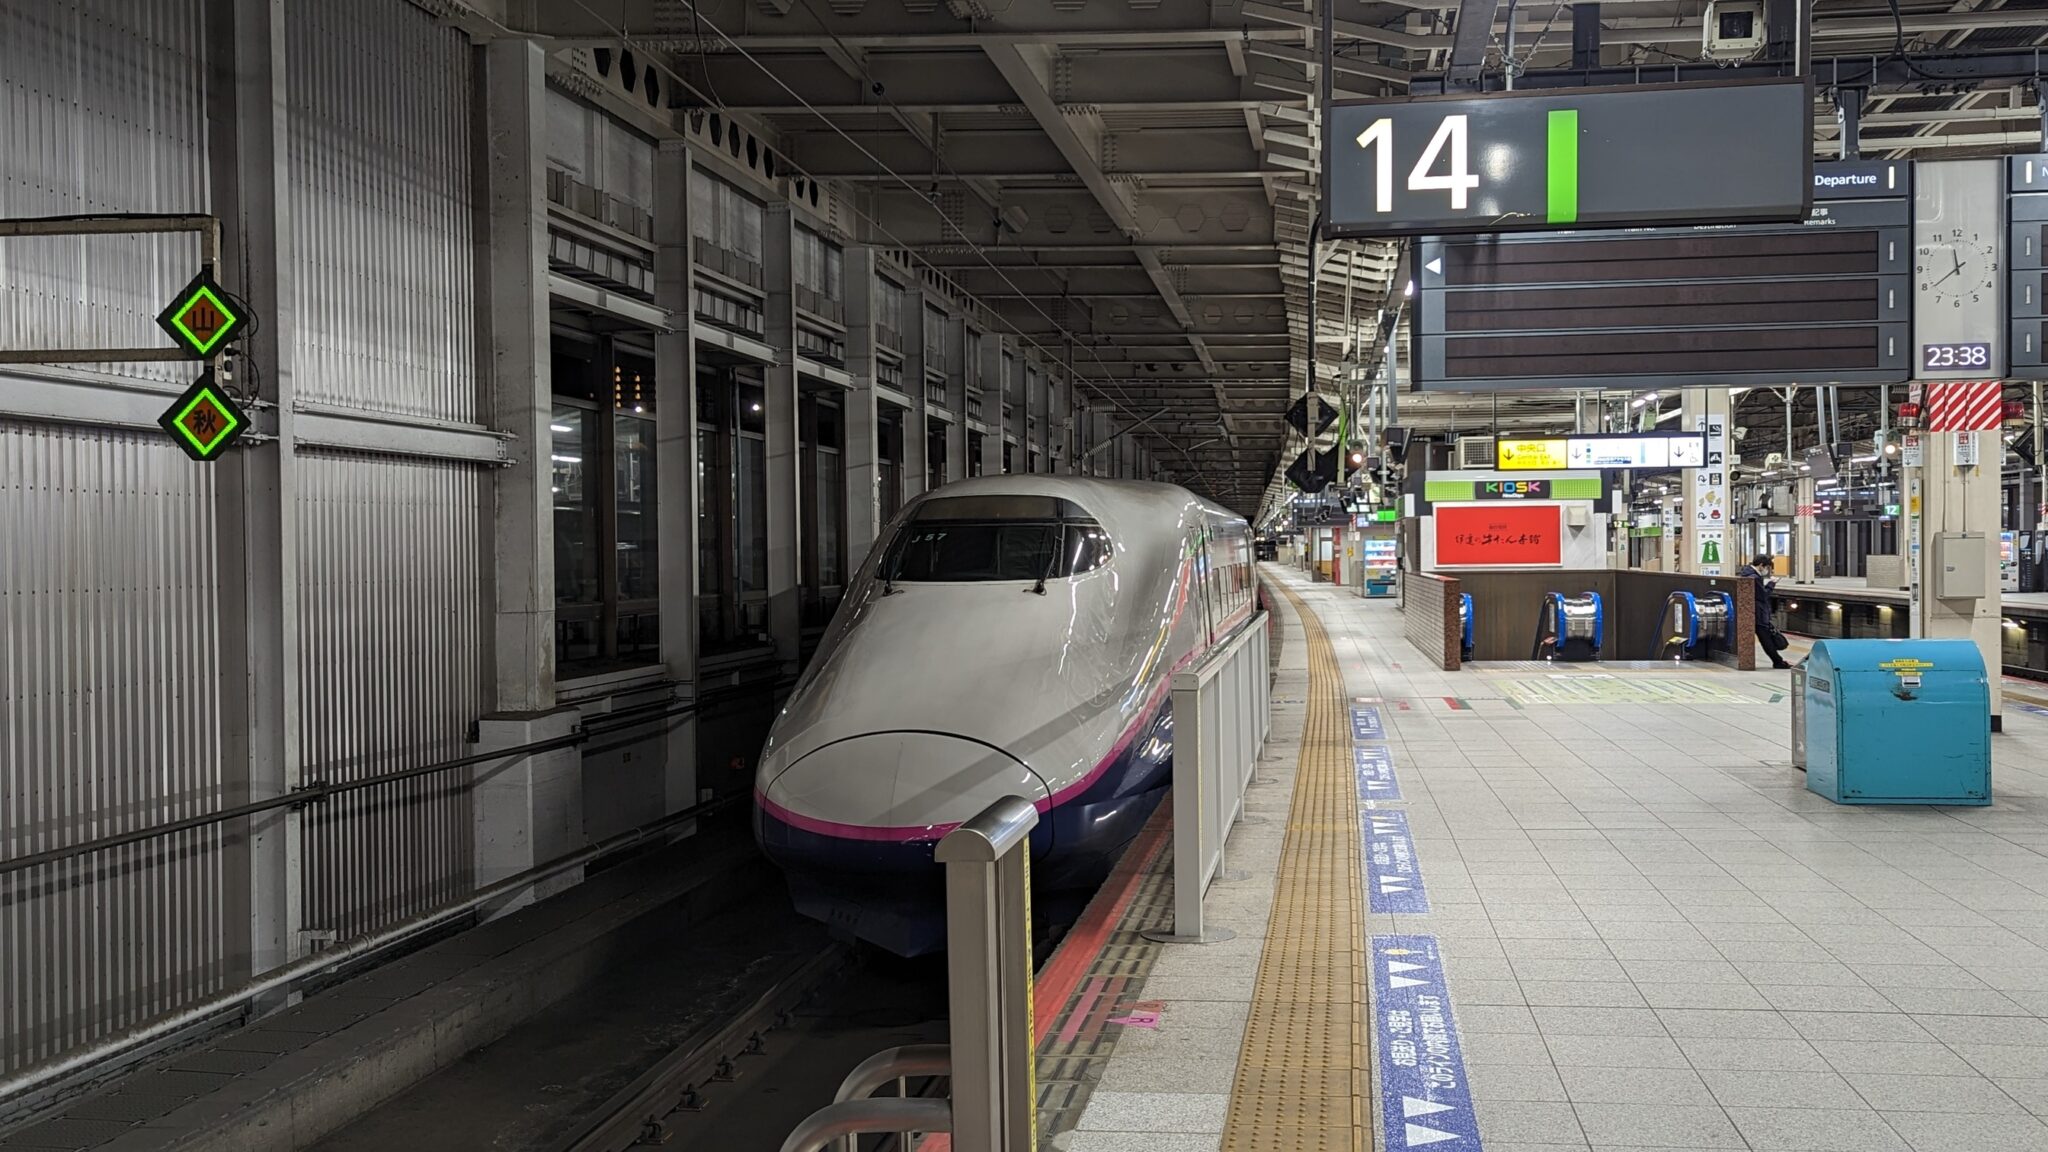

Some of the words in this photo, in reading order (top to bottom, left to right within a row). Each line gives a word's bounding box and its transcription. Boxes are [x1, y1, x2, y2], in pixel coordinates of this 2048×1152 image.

[1356, 114, 1480, 212] 14
[1814, 174, 1877, 188] Departure
[1933, 234, 1942, 242] 11
[1952, 229, 1963, 238] 12
[1973, 233, 1979, 241] 1
[1920, 248, 1930, 256] 10
[1987, 246, 1993, 254] 2
[1916, 266, 1923, 274] 9
[1992, 263, 1998, 271] 3
[1921, 283, 1928, 291] 8
[1986, 281, 1992, 289] 4
[1935, 295, 1942, 304] 7
[1973, 294, 1979, 303] 5
[1954, 300, 1960, 308] 6
[192, 307, 215, 332] 山
[1927, 346, 1987, 367] 23:38
[193, 409, 217, 435] 秋
[1486, 481, 1541, 493] KIOSK
[1885, 505, 1897, 514] 12
